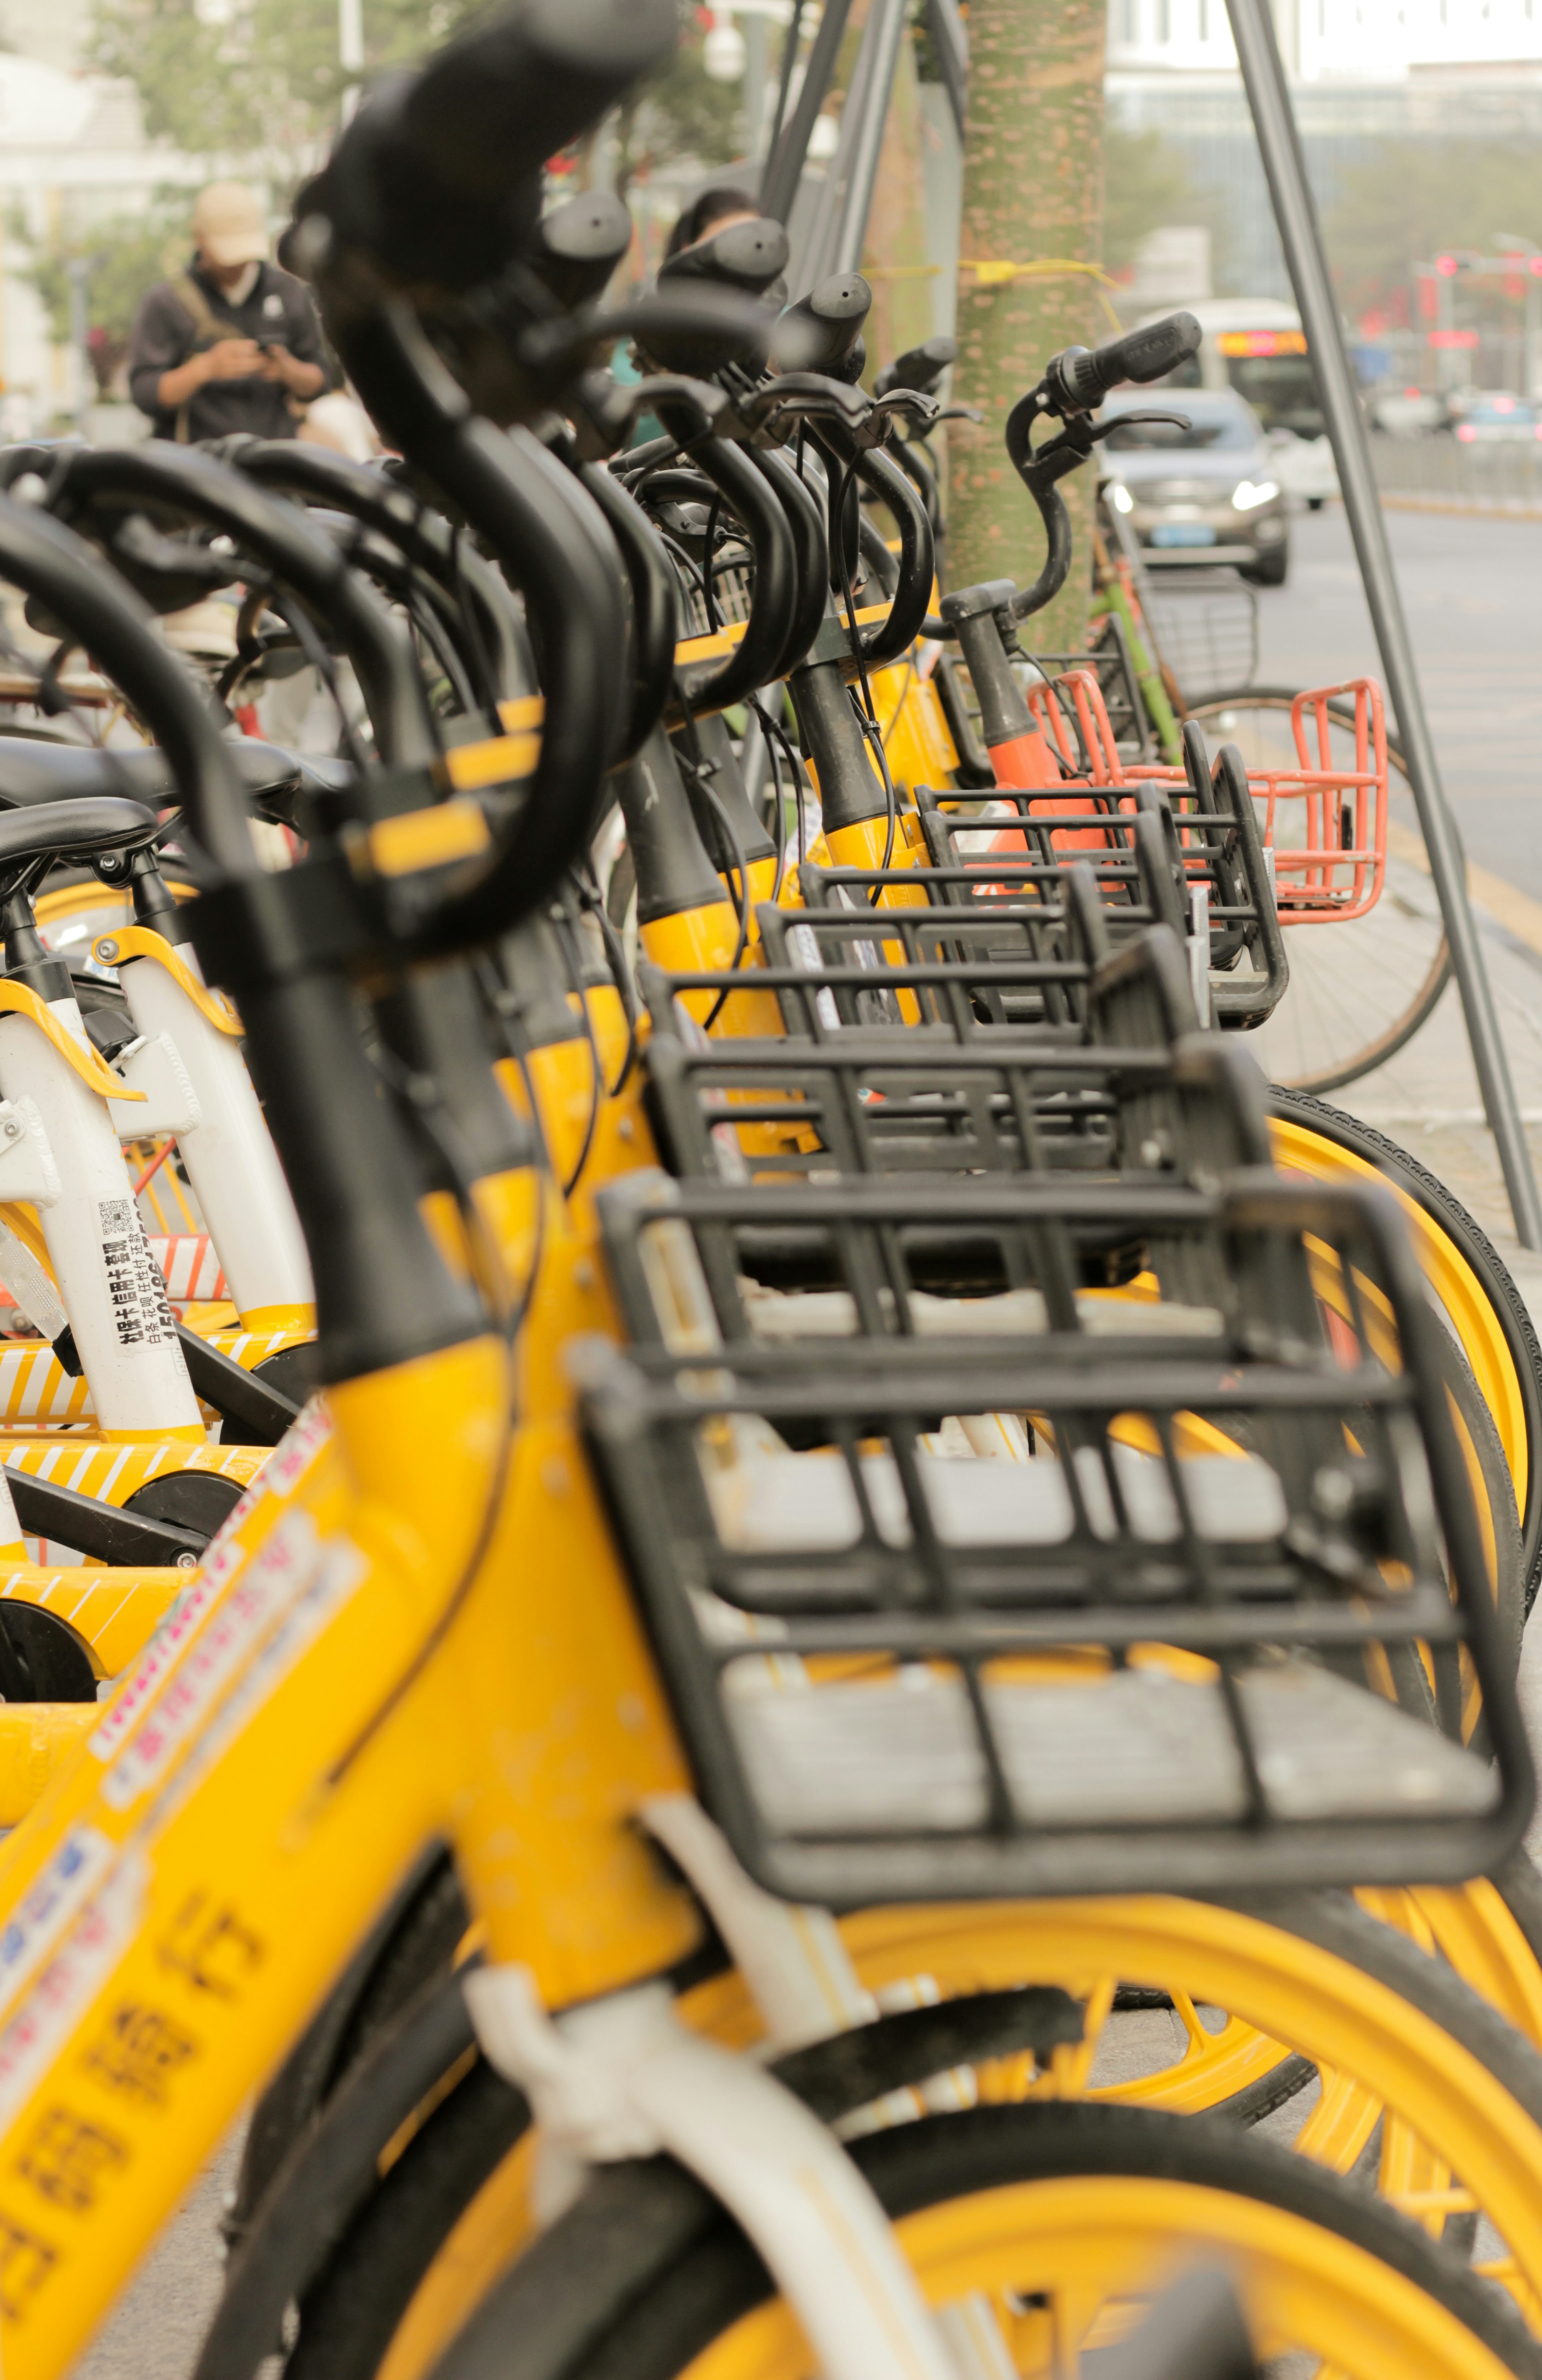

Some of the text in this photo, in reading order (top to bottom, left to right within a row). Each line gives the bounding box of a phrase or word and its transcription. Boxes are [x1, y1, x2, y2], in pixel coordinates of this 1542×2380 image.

[102, 1240, 144, 1344] 社保卡 信用卡 套现
[128, 1233, 161, 1344] 白条 花呗 任性付 还款
